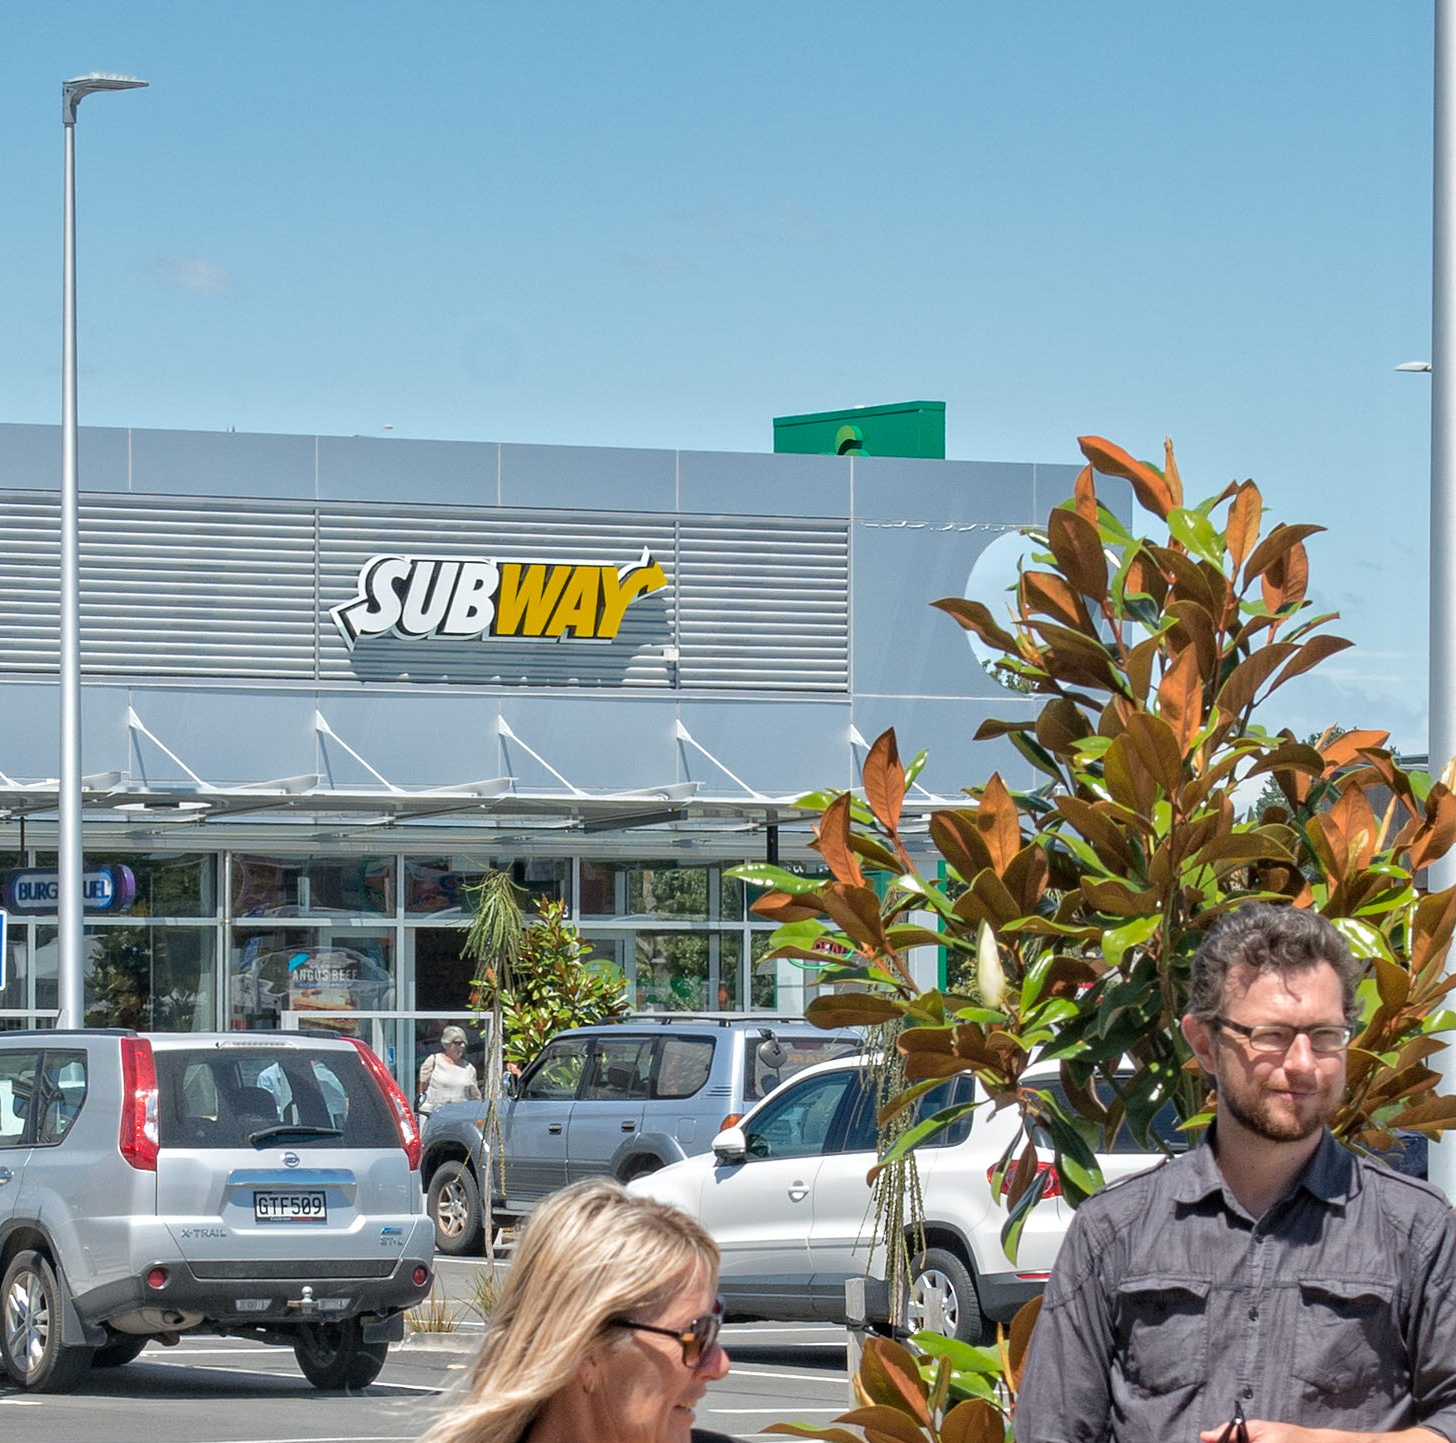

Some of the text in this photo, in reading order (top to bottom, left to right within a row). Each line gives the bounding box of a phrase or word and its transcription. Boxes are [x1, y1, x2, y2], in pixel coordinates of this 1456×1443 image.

[347, 556, 668, 639] SUBWAY
[18, 879, 110, 900] BURGUEL
[292, 969, 358, 981] ANGUS BEEF
[258, 1197, 322, 1216] GTF509
[181, 1228, 227, 1239] X-TRAIL
